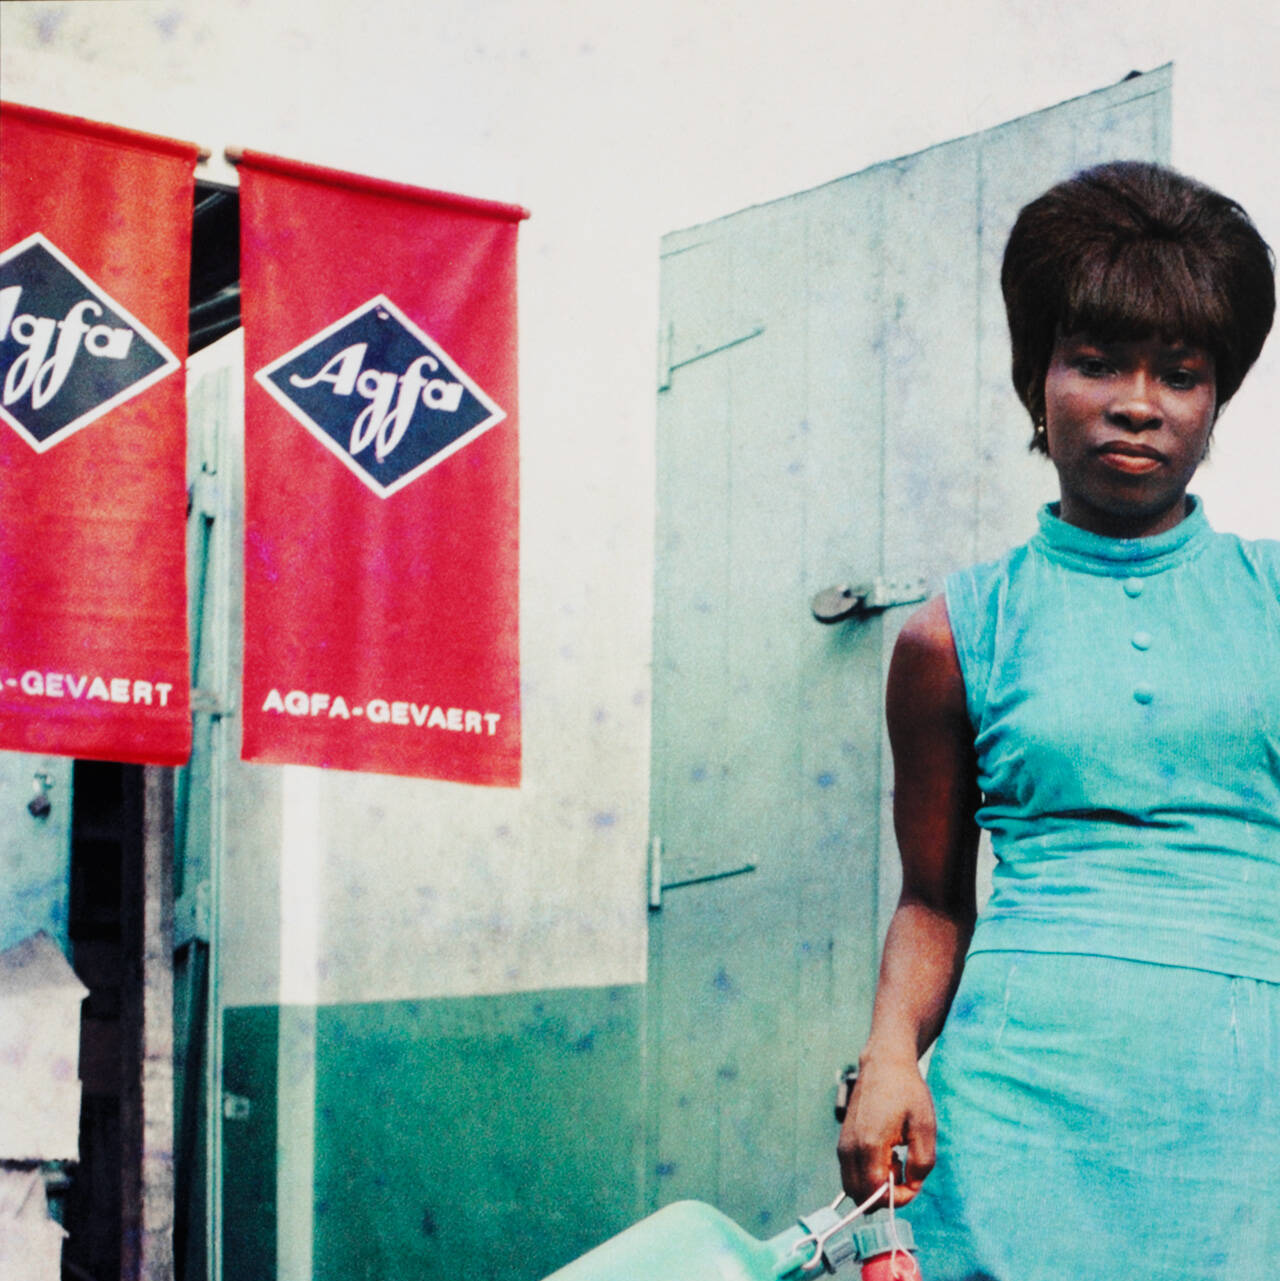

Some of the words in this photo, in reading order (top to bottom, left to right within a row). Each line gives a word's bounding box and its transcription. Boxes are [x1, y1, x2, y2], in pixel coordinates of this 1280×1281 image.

[0, 285, 134, 410] gfa
[289, 342, 464, 460] Agfa
[0, 669, 173, 707] -GEVAERT
[262, 688, 501, 736] AGFA-GEVAERT
